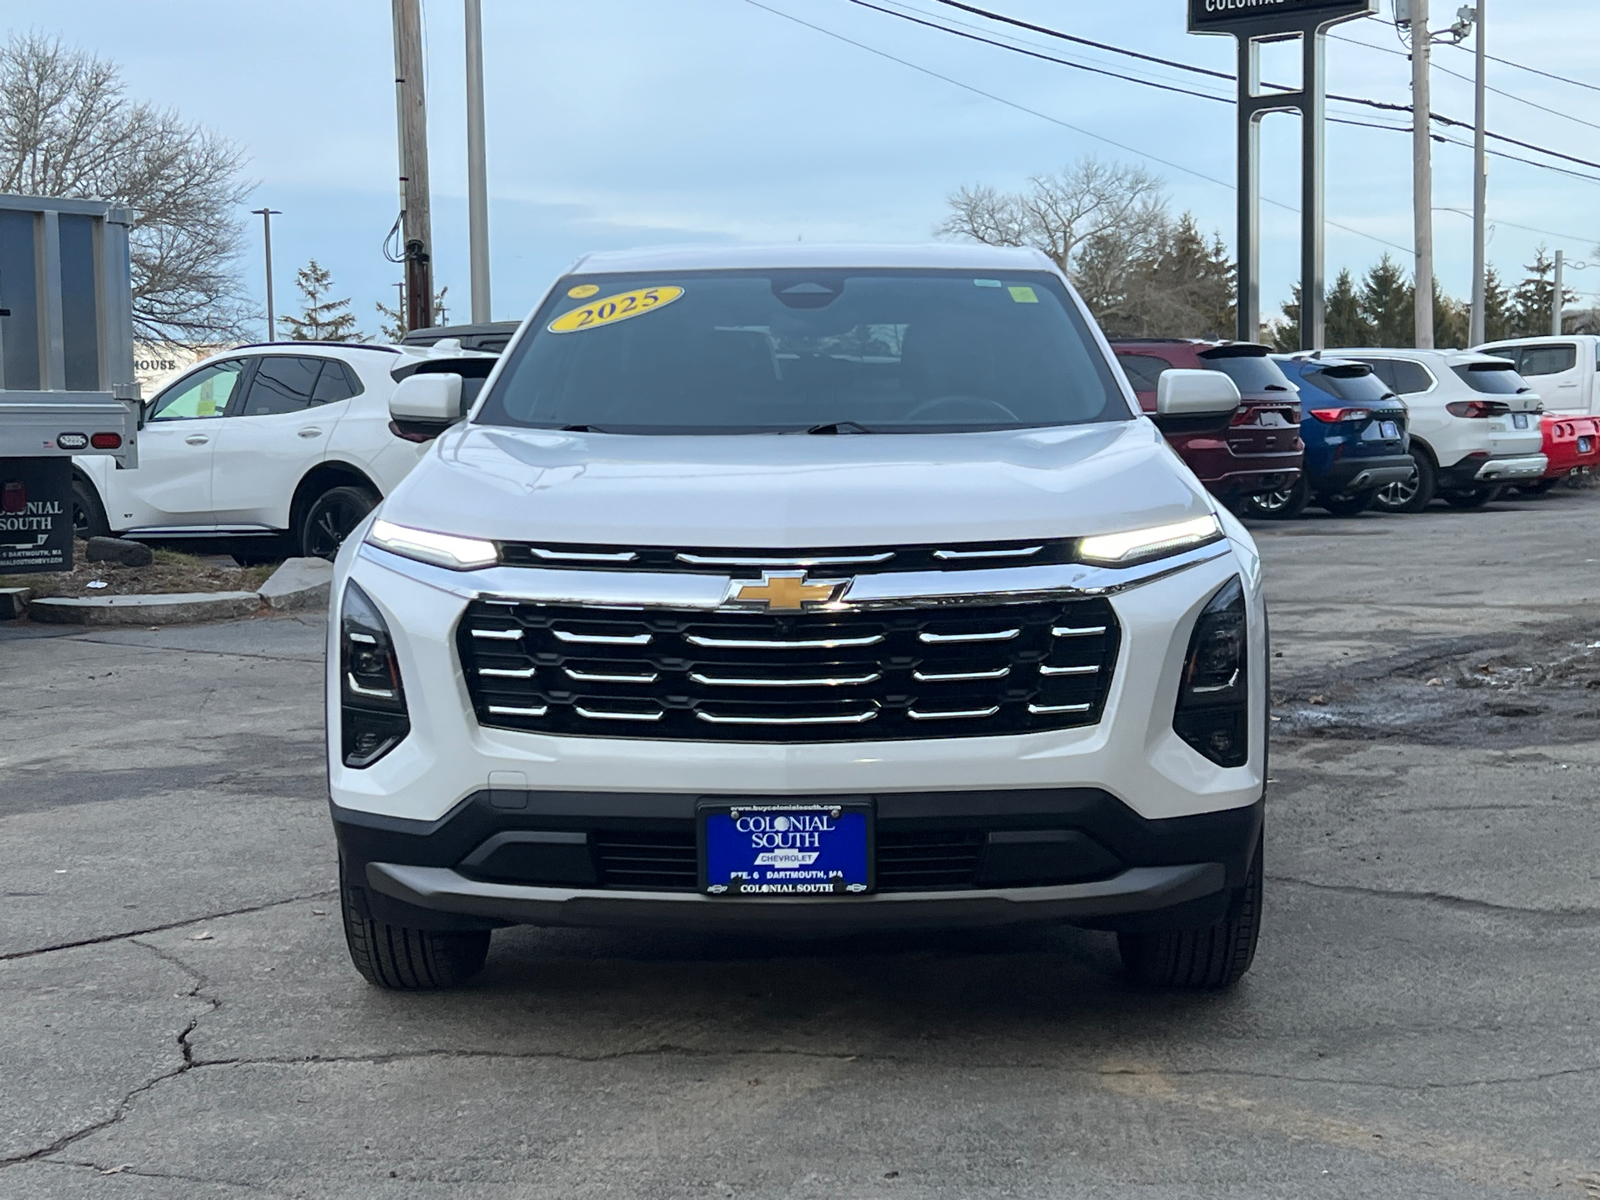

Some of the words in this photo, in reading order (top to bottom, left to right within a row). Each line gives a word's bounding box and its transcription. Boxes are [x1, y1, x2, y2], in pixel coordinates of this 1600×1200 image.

[1205, 0, 1284, 11] COLON
[577, 289, 660, 328] 2025
[0, 501, 63, 515] NIAL
[0, 517, 52, 530] SOUTH
[736, 816, 836, 832] COLONIAL
[751, 832, 820, 848] SOUTH
[761, 854, 812, 862] CHEVROLET
[753, 871, 760, 880] 6
[766, 871, 827, 880] DARTMOUTH,
[740, 884, 795, 893] COLONIAL
[796, 884, 835, 893] SOUTH
